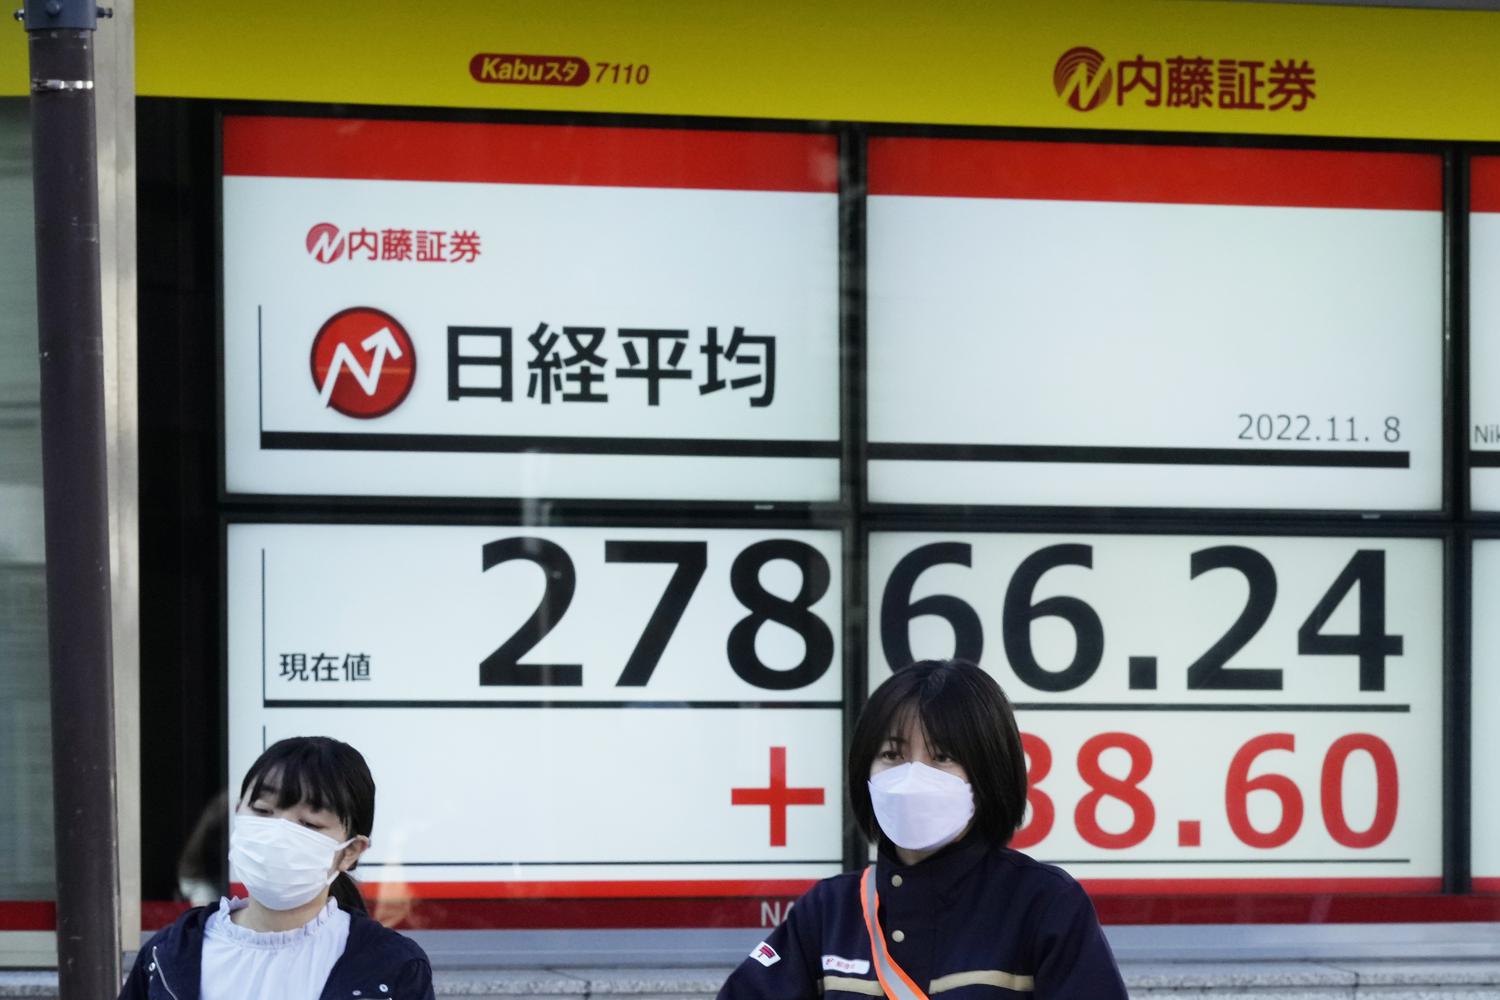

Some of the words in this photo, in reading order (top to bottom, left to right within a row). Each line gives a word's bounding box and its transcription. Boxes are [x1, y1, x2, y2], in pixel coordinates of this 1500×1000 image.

[480, 57, 582, 84] Kabuスタ
[596, 62, 650, 85] 7110
[1116, 55, 1317, 112] 内藤証券
[347, 228, 481, 264] 内藤証券
[447, 322, 776, 408] 日経平均
[279, 652, 371, 683] 現在値
